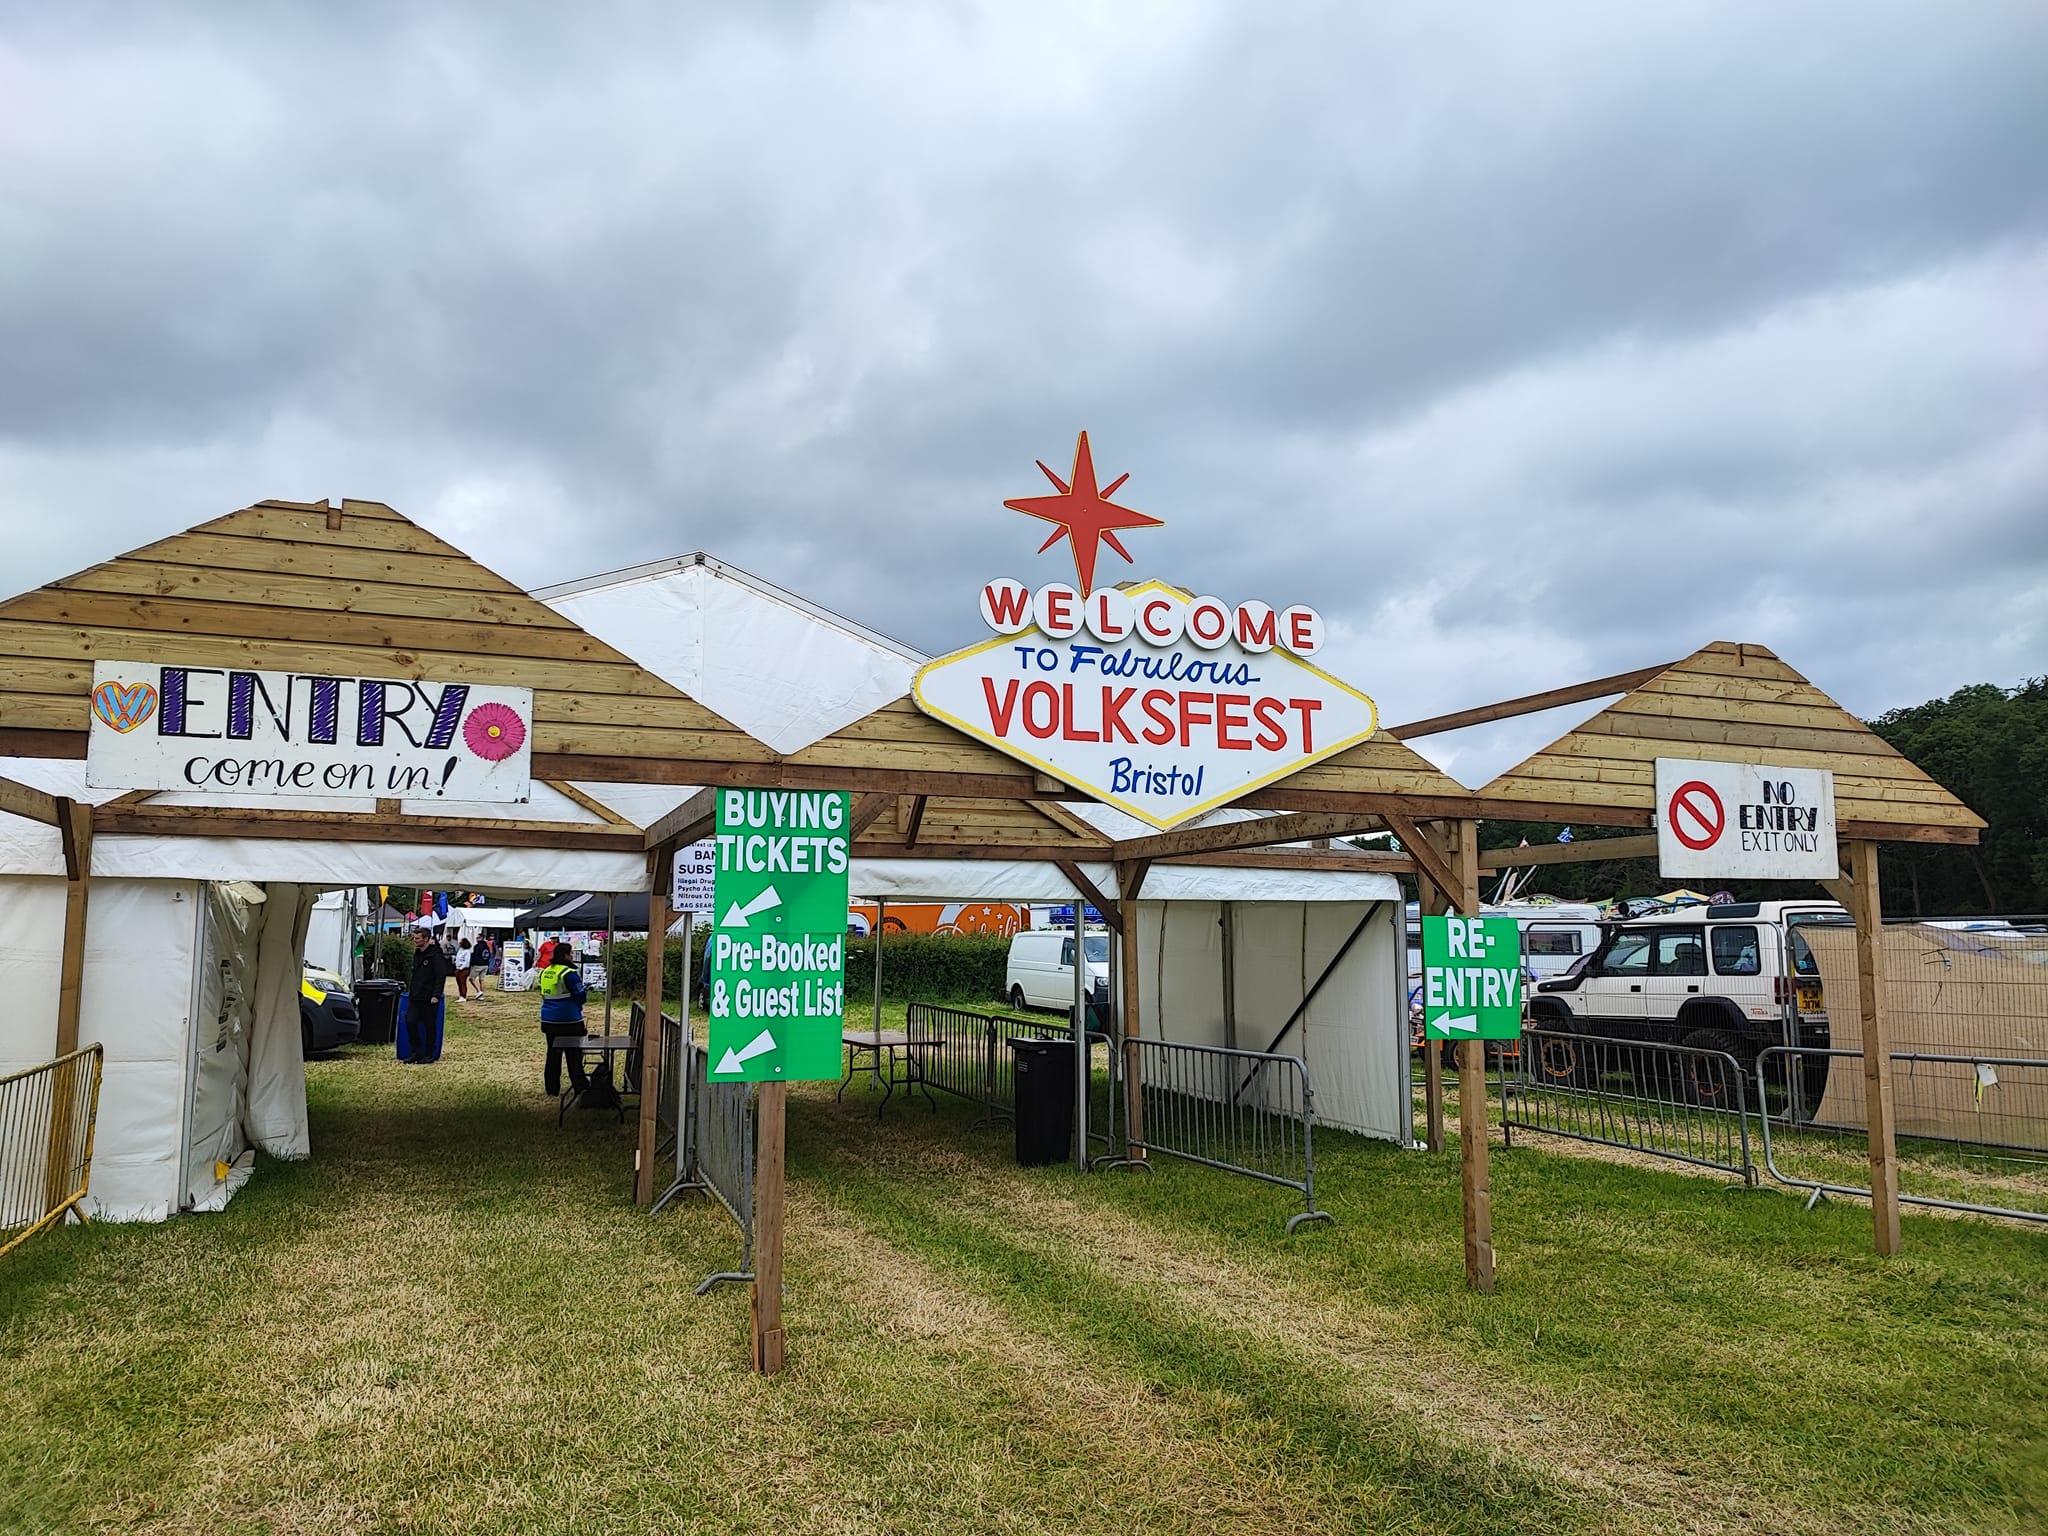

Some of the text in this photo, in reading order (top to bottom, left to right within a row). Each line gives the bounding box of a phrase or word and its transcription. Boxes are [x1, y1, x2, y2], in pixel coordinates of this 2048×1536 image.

[984, 584, 1314, 650] WELCOME
[1014, 643, 1261, 686] TO Fabulous
[157, 666, 471, 750] ENTRY
[981, 676, 1323, 755] VOLKSFEST
[183, 751, 459, 797] come on in!
[1108, 756, 1205, 797] Bristol
[1763, 780, 1796, 806] NO
[724, 789, 844, 831] BUYING
[1739, 804, 1818, 832] ENTRY
[716, 834, 848, 875] TICKETS
[1741, 830, 1819, 853] EXIT ONLY
[716, 933, 842, 972] Pre-Booked
[1447, 918, 1496, 959] RE-
[711, 977, 843, 1018] & Guest List
[1426, 967, 1519, 1008] ENTRY
